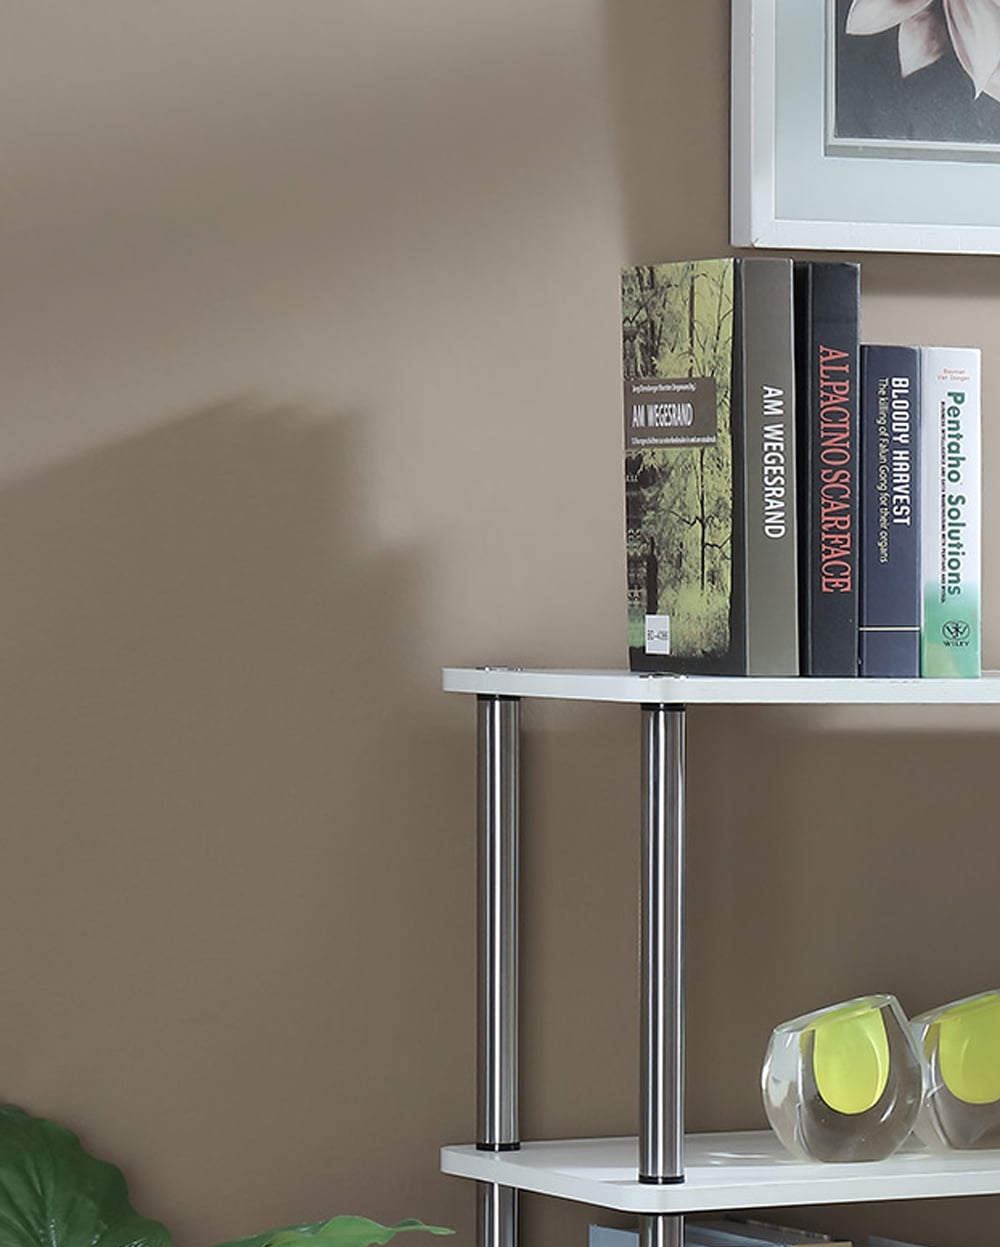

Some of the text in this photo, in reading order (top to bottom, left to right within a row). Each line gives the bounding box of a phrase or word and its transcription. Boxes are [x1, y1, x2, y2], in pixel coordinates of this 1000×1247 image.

[763, 385, 786, 539] AM WEGESRAND
[876, 377, 890, 563] The killing of Falun Gong for their organs
[891, 377, 911, 526] BLOODY HARVEST
[947, 391, 967, 596] Pentaho Solutions
[819, 469, 852, 593] SCARFACE
[943, 640, 970, 648] WILEY
